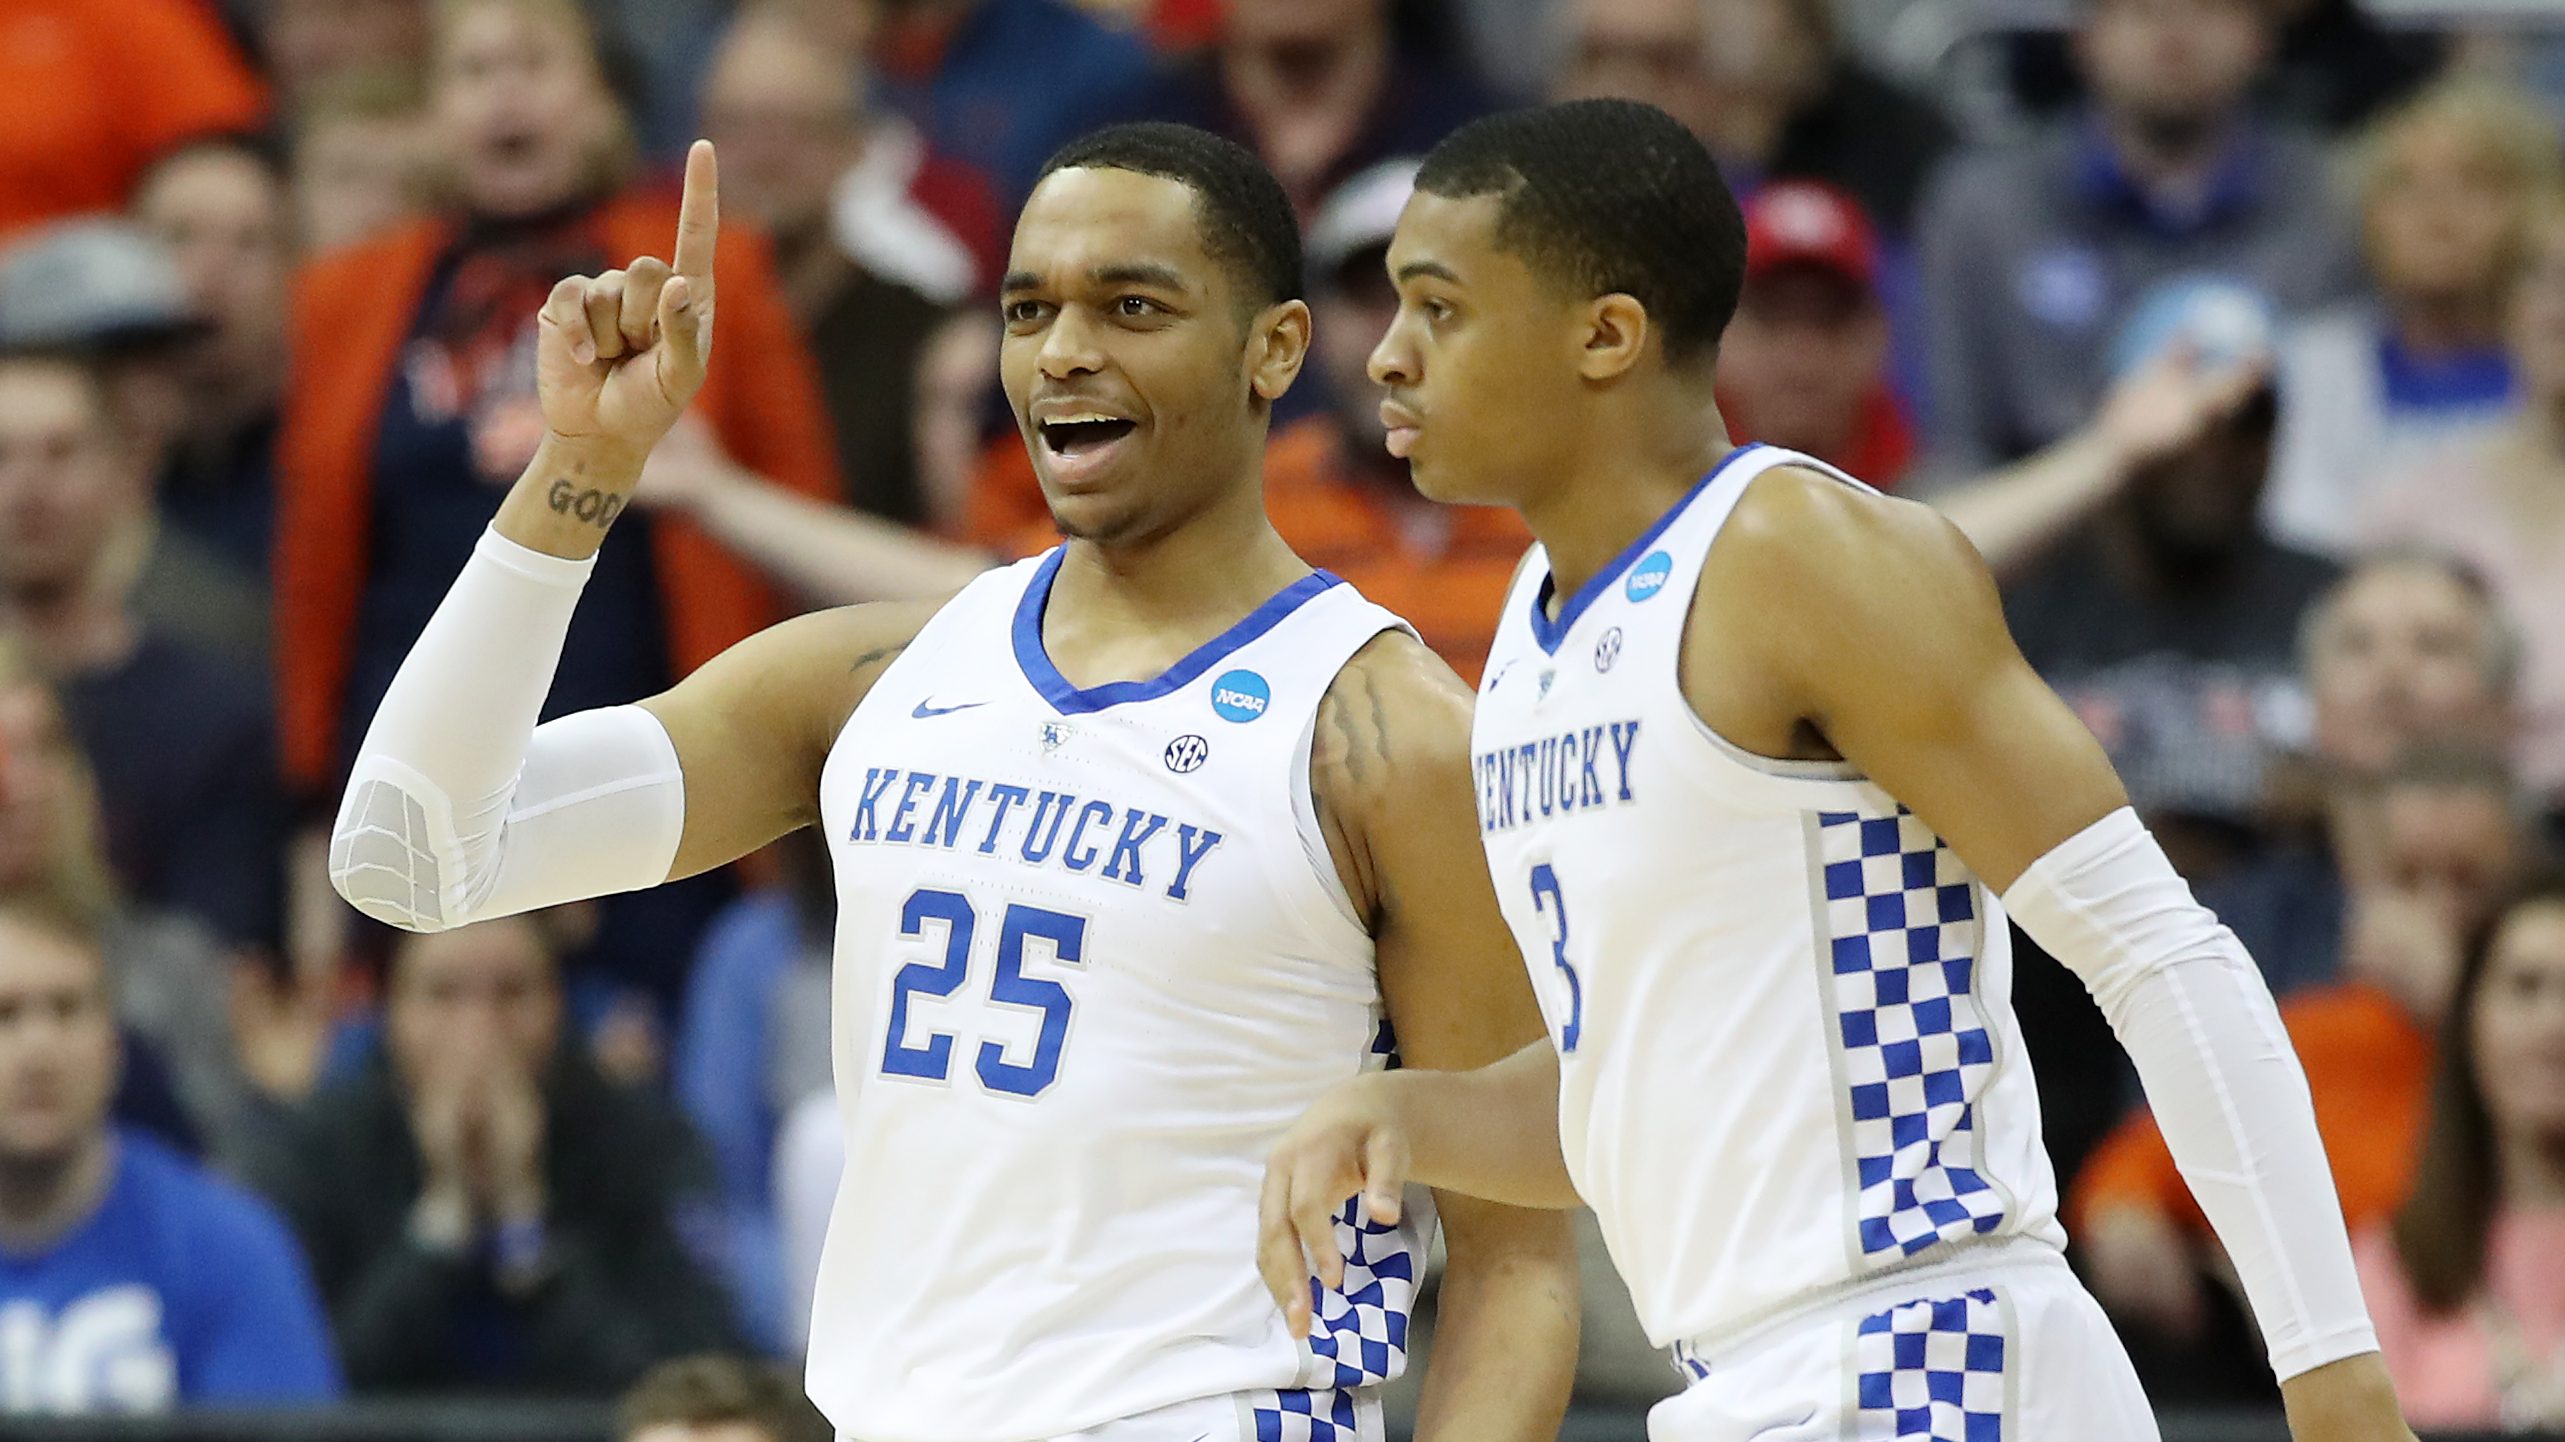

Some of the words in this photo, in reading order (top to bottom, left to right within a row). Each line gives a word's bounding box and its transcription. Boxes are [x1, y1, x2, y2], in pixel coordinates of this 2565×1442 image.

[1165, 735, 1208, 773] SEC
[1216, 688, 1265, 713] NCAA
[849, 768, 1223, 902] KENTUCKY
[881, 888, 1086, 1097] 25
[1530, 863, 1581, 1053] 3
